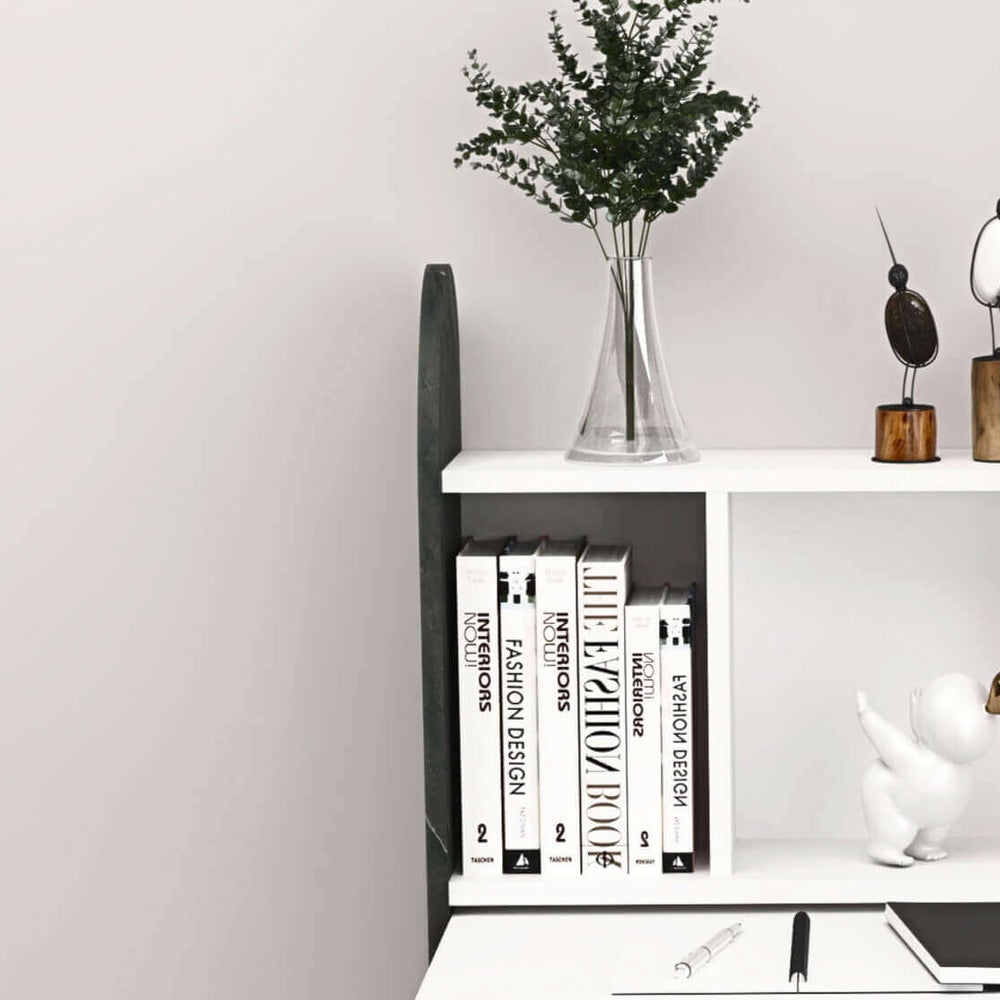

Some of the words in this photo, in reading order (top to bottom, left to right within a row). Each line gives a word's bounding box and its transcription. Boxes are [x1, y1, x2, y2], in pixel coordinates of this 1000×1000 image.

[464, 612, 477, 667] NOW!
[477, 612, 491, 712] INTERIORS
[543, 612, 556, 667] NOW!
[556, 612, 570, 712] INTERIORS
[505, 639, 524, 720] FASHION
[508, 727, 526, 796] DESIGN
[477, 823, 488, 843] 2
[555, 823, 566, 842] 2
